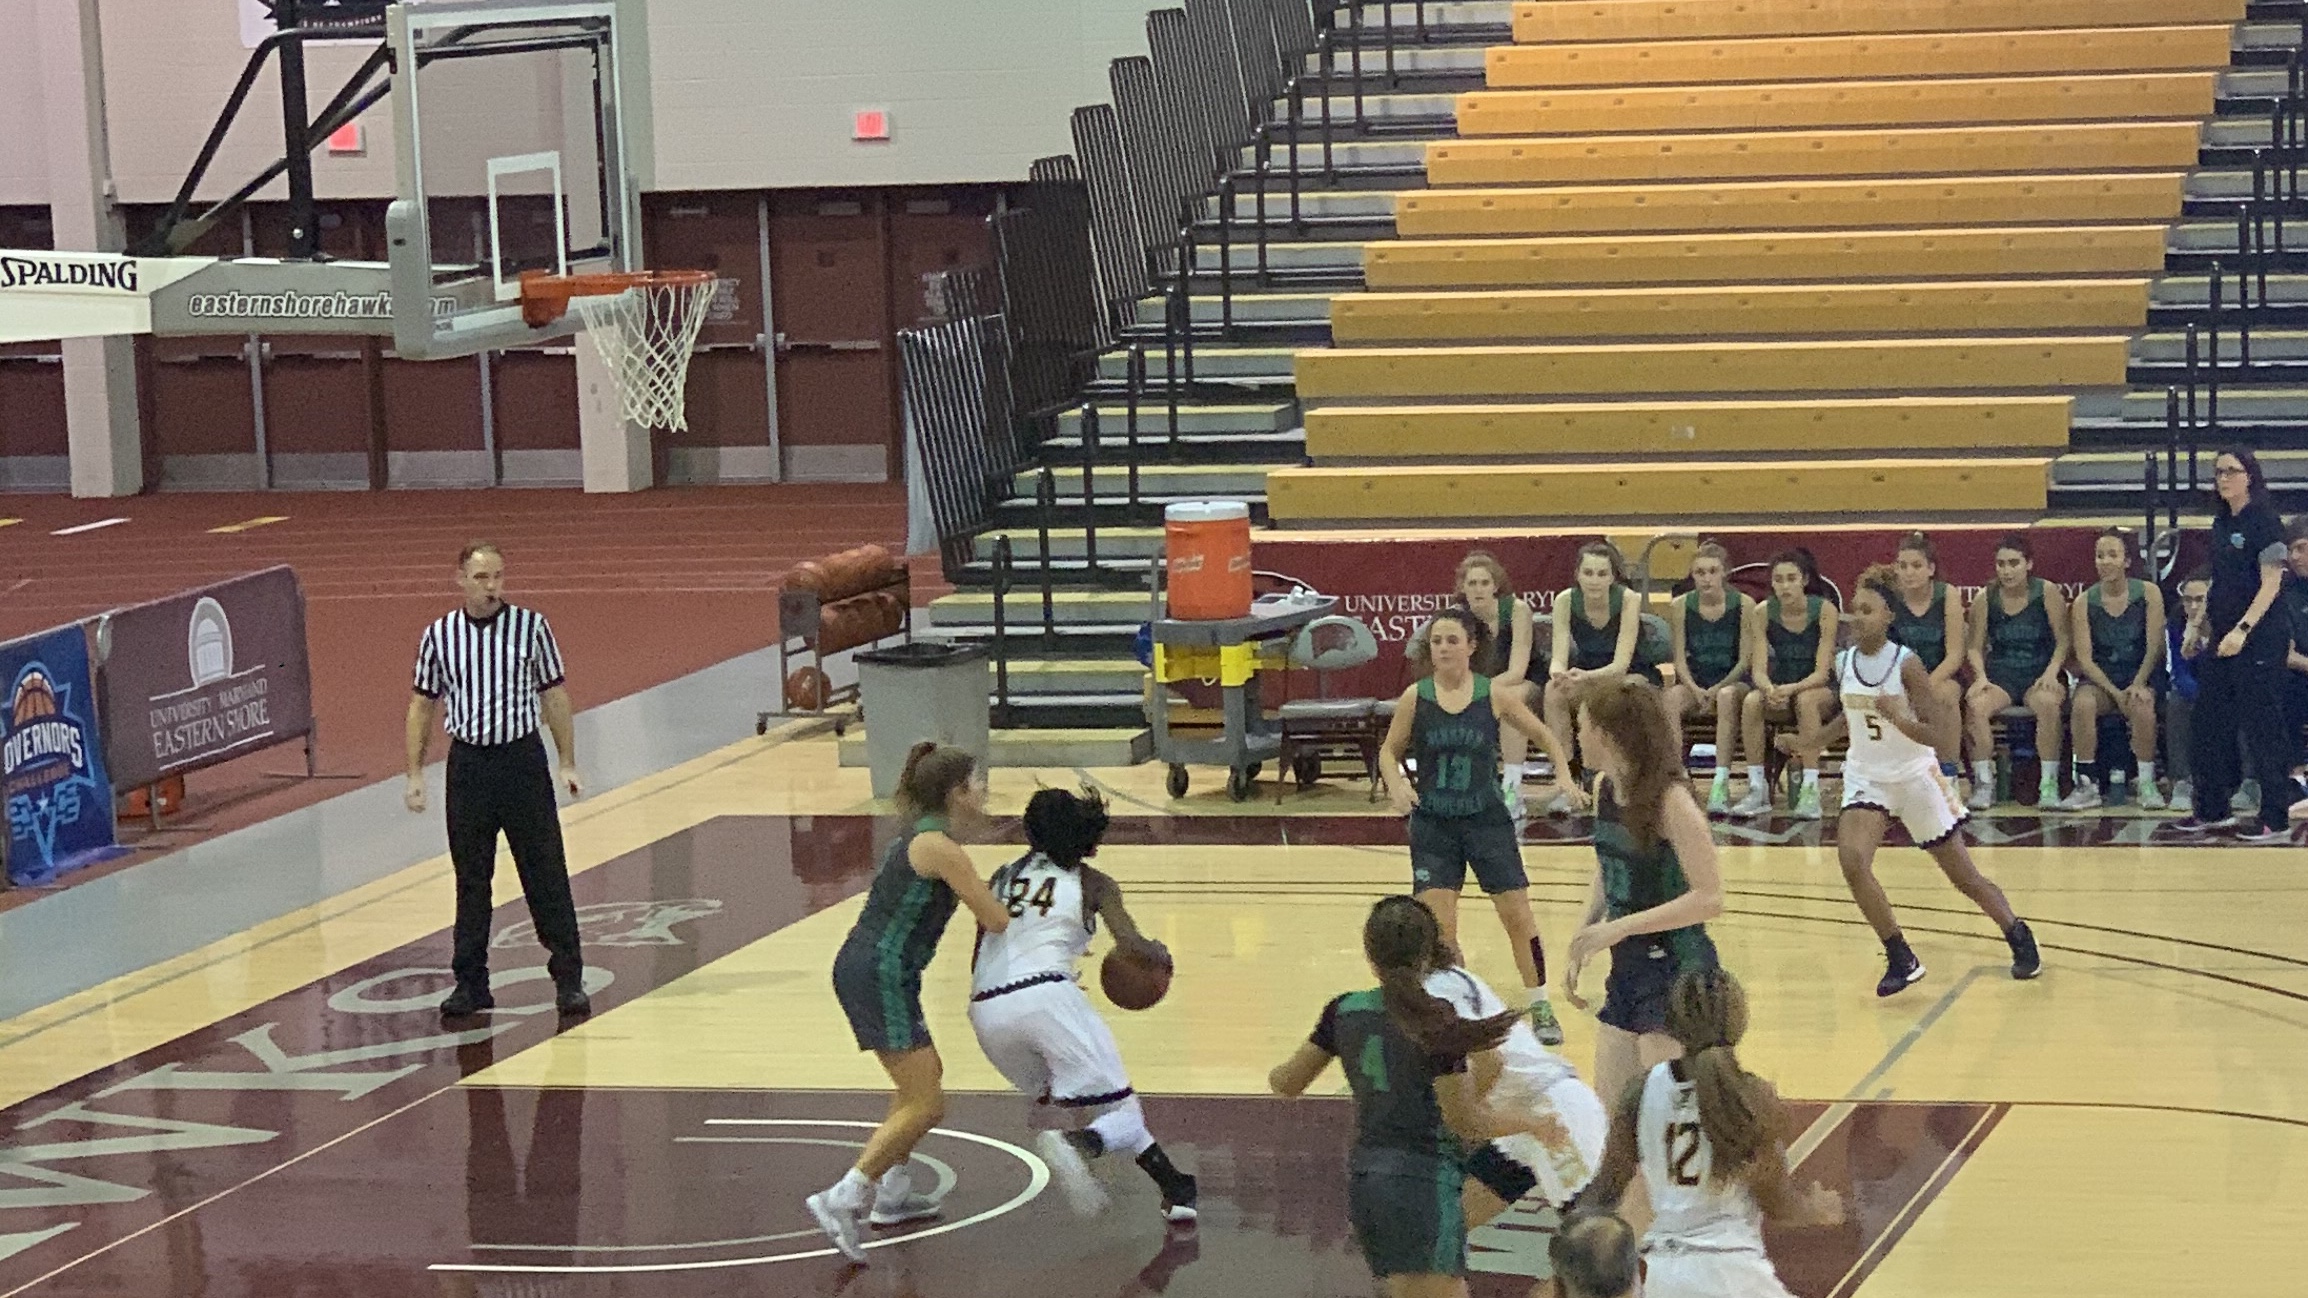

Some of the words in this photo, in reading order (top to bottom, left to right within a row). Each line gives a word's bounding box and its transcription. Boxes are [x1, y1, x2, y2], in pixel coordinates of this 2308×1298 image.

[0, 256, 137, 292] SPALDING
[188, 290, 457, 318] easternshorehawkm
[1345, 594, 1454, 613] UNIVERSIT
[4, 721, 83, 775] OVERNORS
[153, 717, 225, 758] EASTERN
[226, 699, 270, 738] SHORE
[1865, 714, 1883, 741] 5
[1008, 876, 1057, 918] 24
[1361, 1034, 1391, 1092] 4
[0, 965, 616, 1258] WKS
[1665, 1122, 1701, 1186] 12
